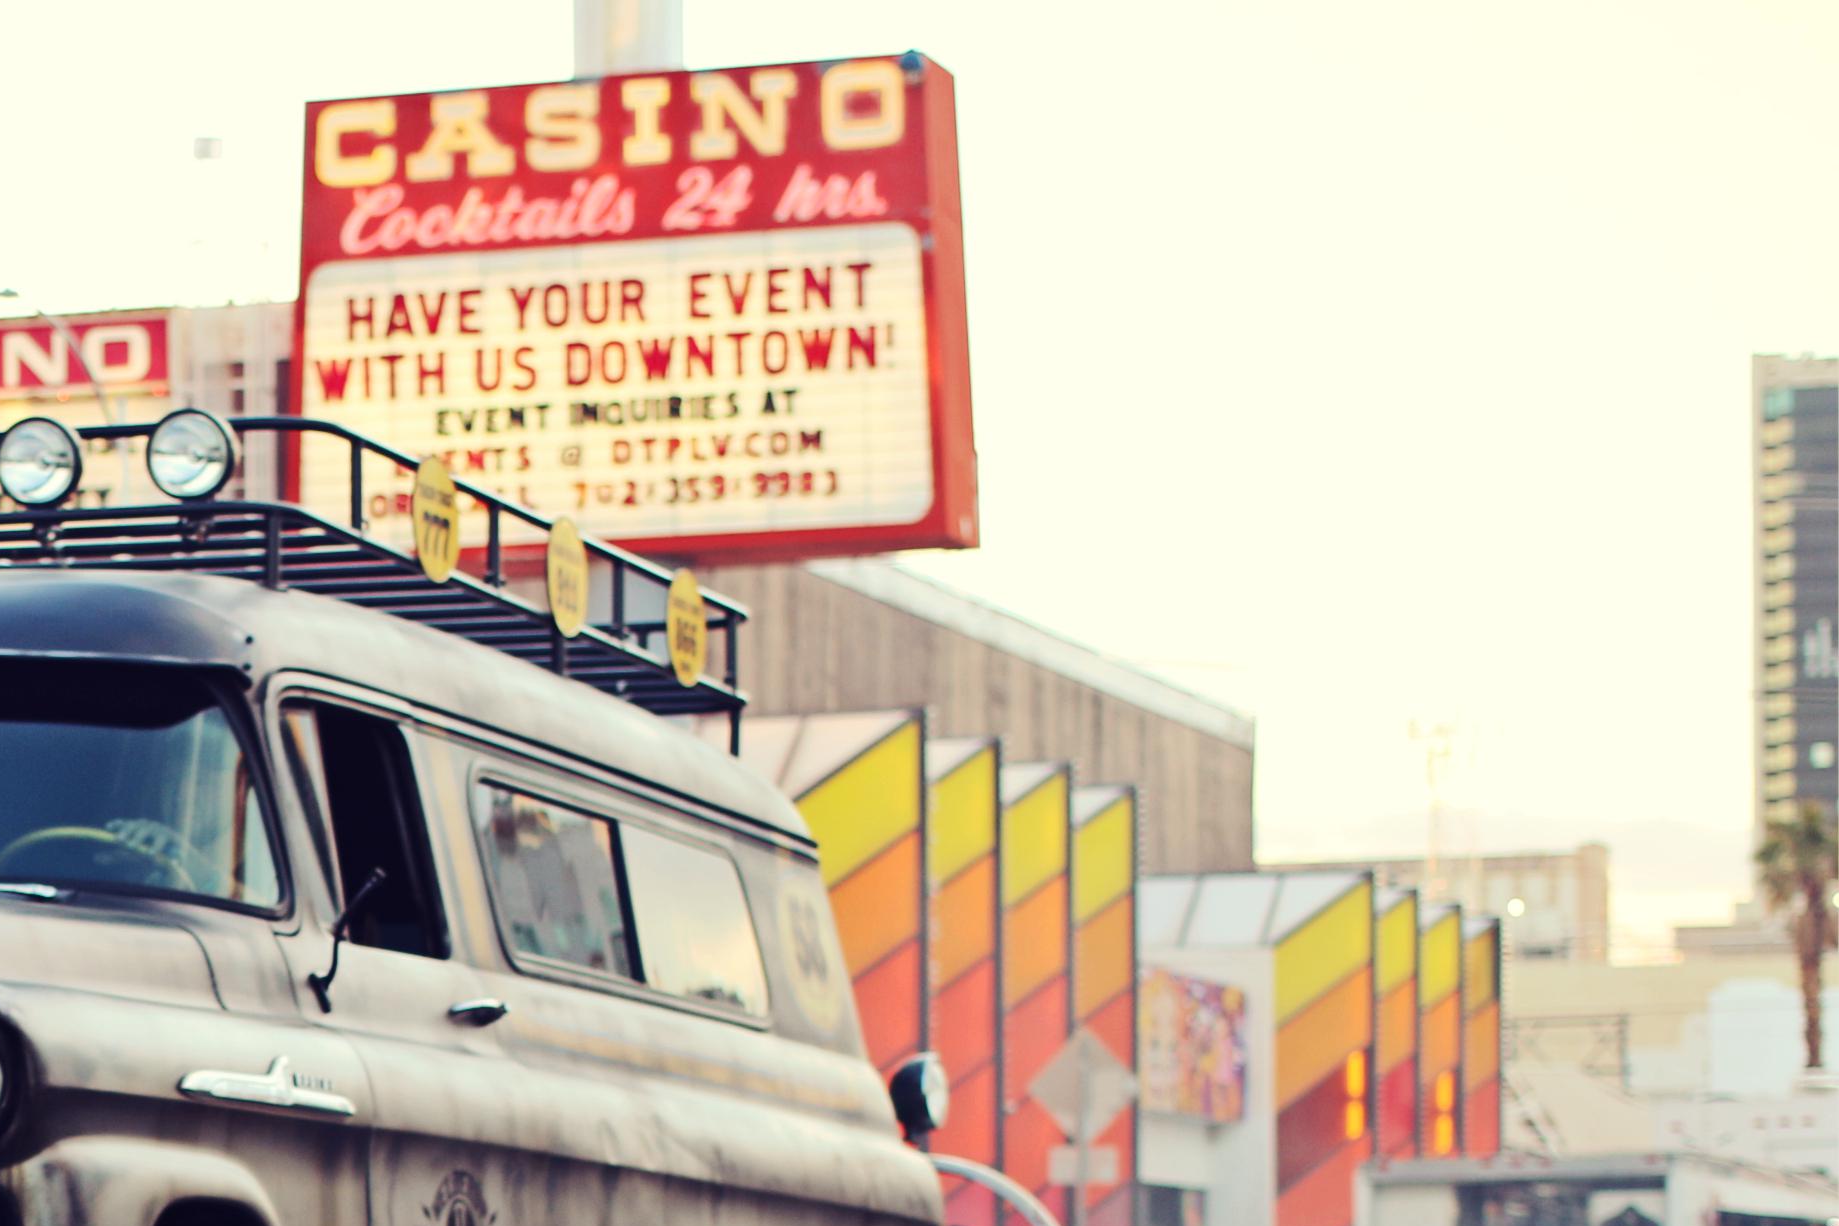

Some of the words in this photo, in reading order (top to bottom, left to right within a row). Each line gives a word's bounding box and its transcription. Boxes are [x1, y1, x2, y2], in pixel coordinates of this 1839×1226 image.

[314, 61, 906, 188] CASINO
[339, 172, 636, 256] Cocktails
[661, 164, 753, 231] 24
[346, 289, 483, 342] HAVE
[509, 279, 646, 330] YOUR
[688, 262, 872, 318] EVENT
[315, 351, 445, 402] WITH
[476, 346, 537, 391] US
[565, 322, 895, 387] DOWNTOWN!
[435, 403, 549, 437] EVENT
[570, 393, 739, 427] INQUIRIES
[762, 389, 798, 415] AT
